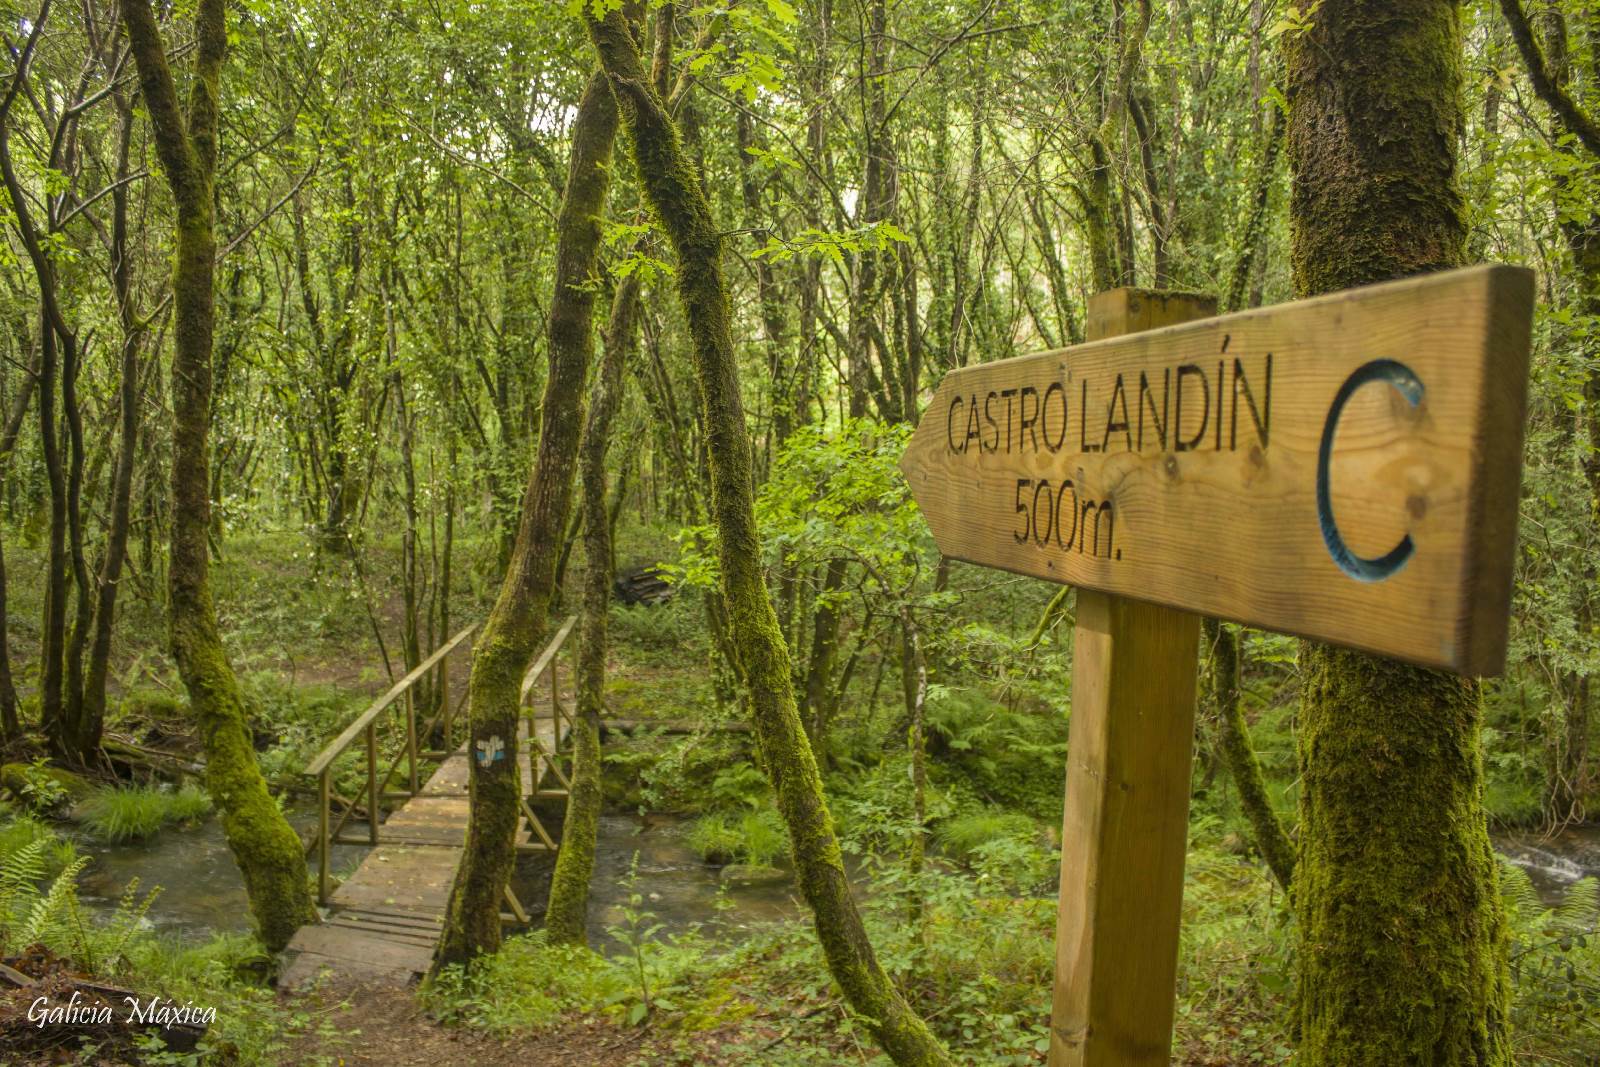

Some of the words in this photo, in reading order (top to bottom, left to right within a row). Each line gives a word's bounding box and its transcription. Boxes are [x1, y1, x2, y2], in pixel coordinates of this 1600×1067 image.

[947, 382, 1068, 456] CASTRO
[1080, 334, 1273, 453] LANDÍN
[1013, 478, 1122, 562] 500m.
[1316, 358, 1426, 584] C
